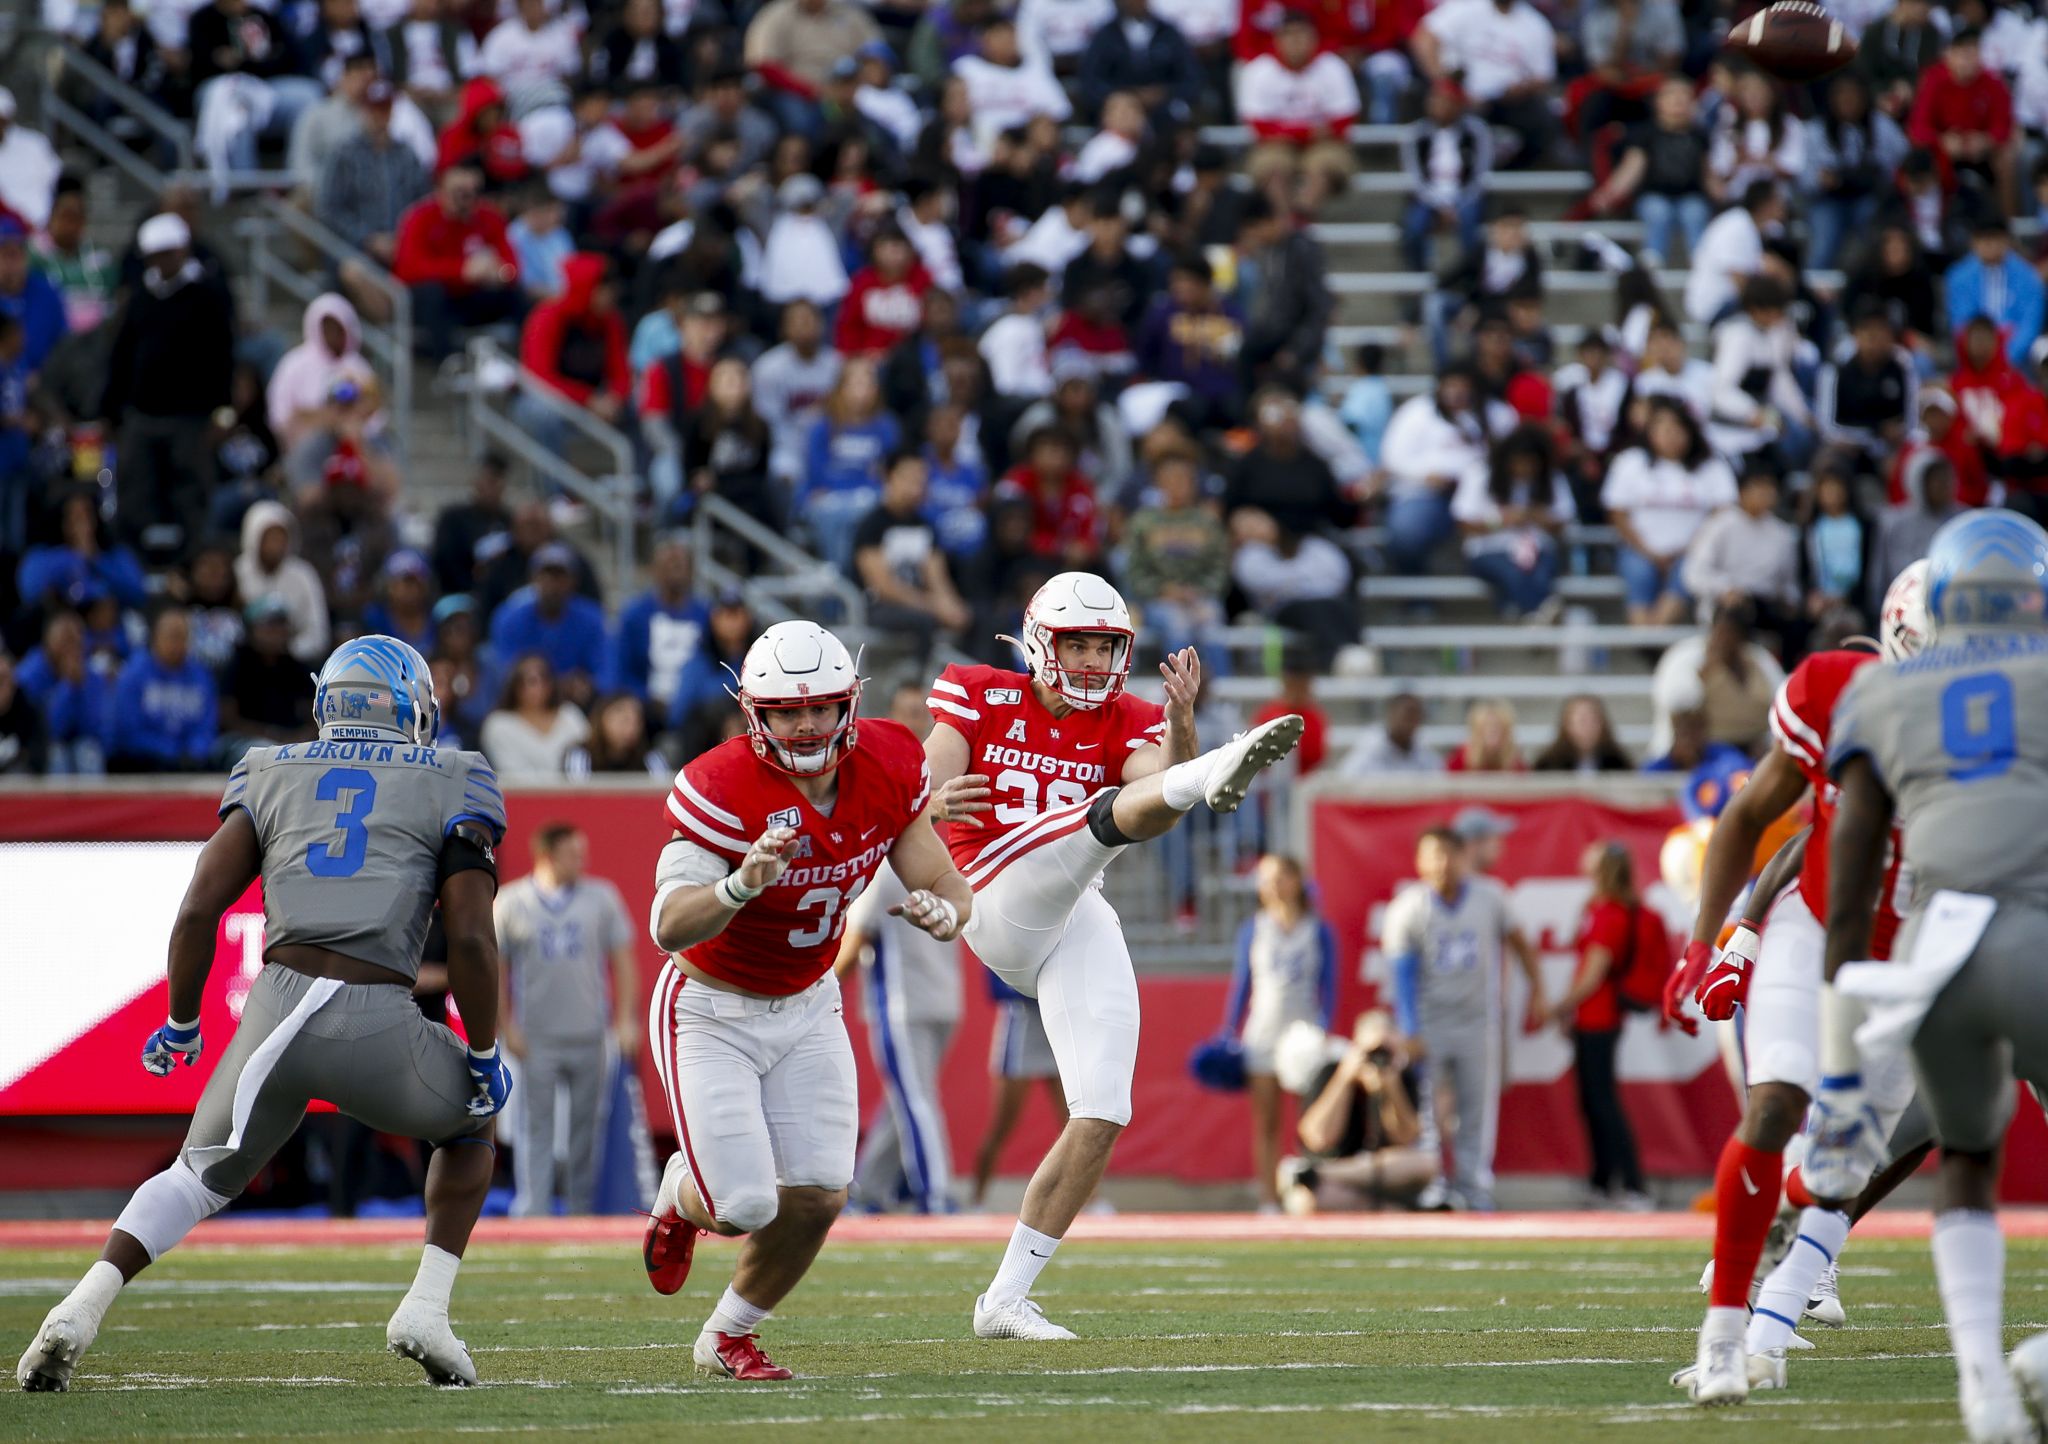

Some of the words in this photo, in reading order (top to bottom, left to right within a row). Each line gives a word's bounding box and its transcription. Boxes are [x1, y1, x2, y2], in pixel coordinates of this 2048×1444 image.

[986, 689, 1021, 704] 150
[331, 728, 379, 738] MEMPHIS
[1005, 719, 1026, 742] A
[1942, 670, 2017, 784] 9
[275, 744, 296, 761] K.
[304, 740, 394, 762] BROWN
[403, 747, 443, 769] JR.
[983, 744, 1105, 783] HOUSTON
[305, 768, 377, 877] 3
[768, 807, 800, 828] 150
[774, 837, 894, 887] HOUSTON
